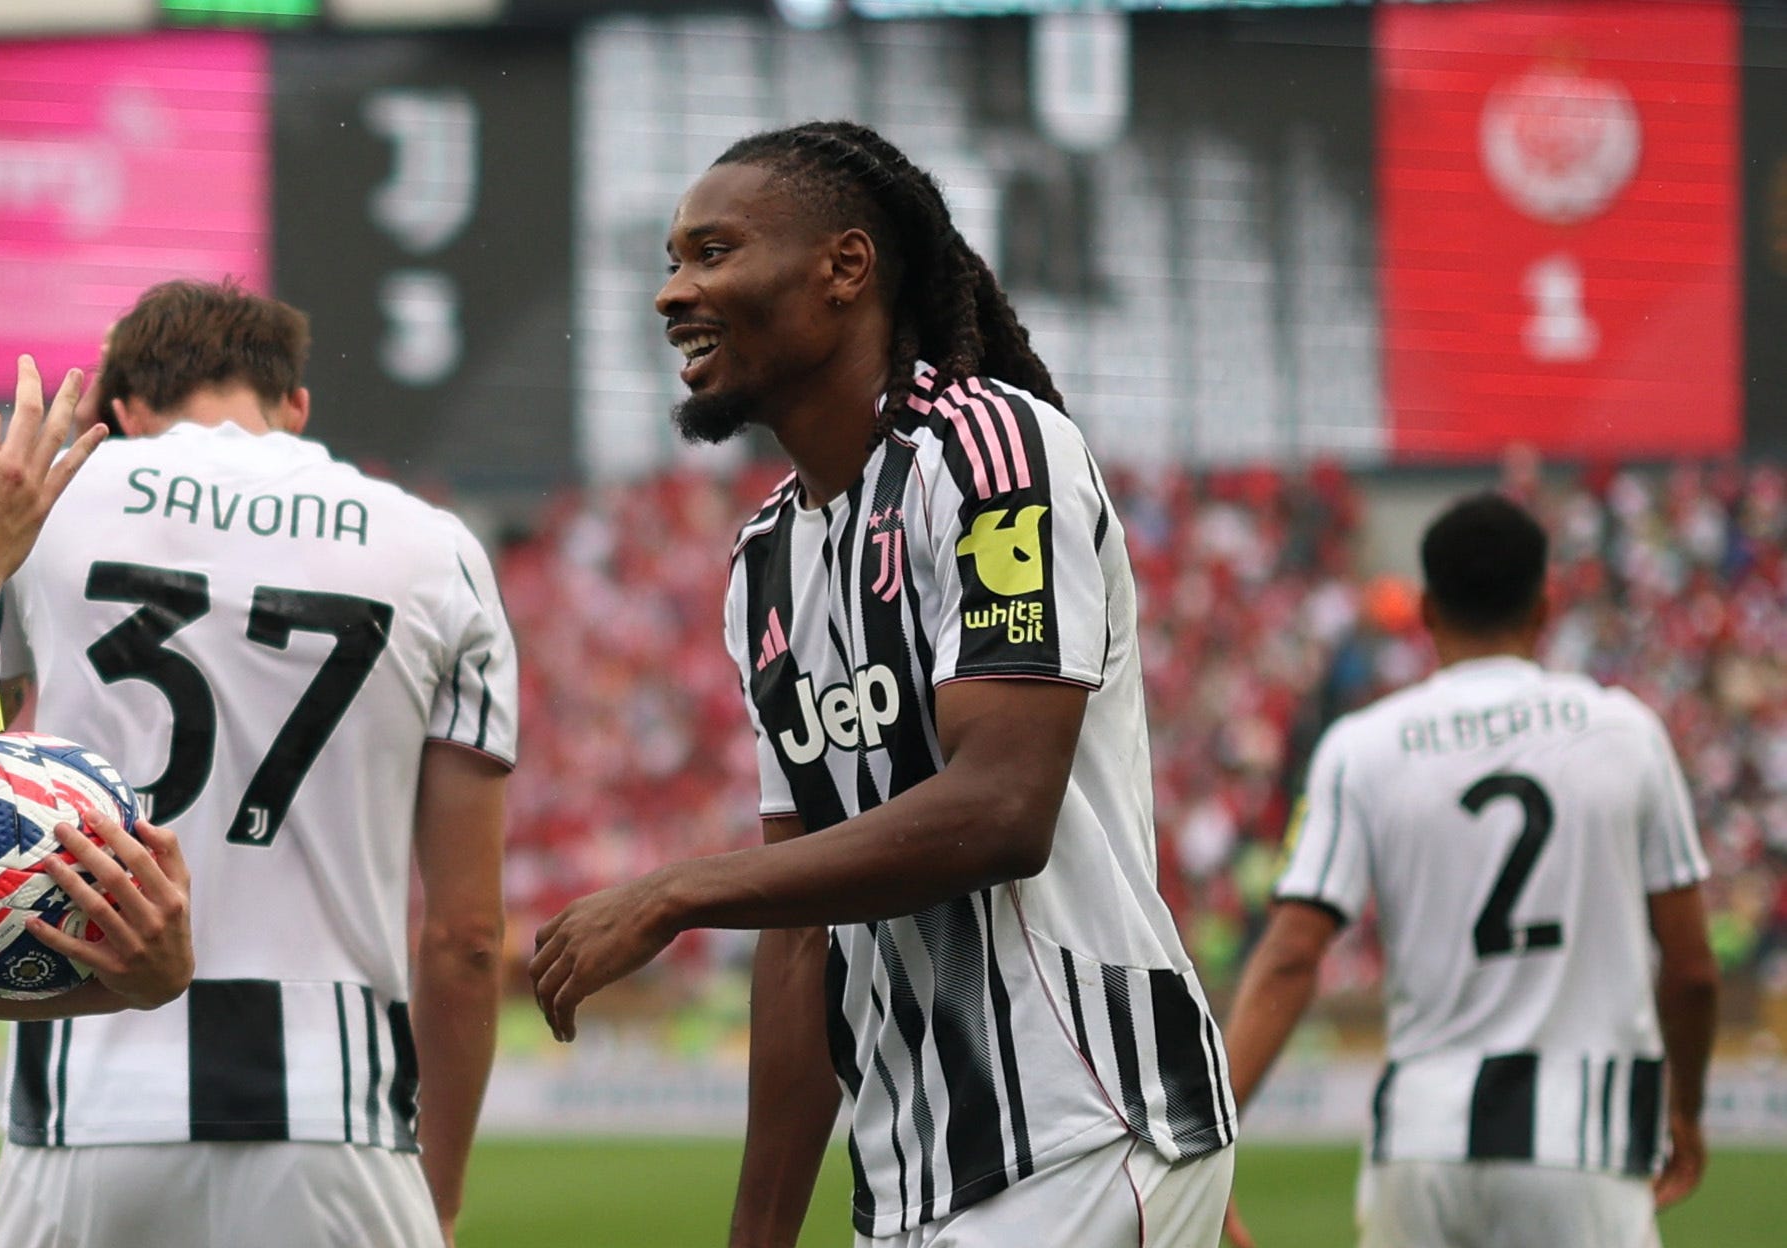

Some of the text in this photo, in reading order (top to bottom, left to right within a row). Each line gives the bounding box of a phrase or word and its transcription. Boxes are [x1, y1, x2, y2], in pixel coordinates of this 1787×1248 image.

[123, 468, 369, 546] SAVONA
[965, 600, 1043, 630] white
[1007, 618, 1044, 644] bit
[85, 560, 395, 847] 37
[1459, 772, 1563, 959] 2
